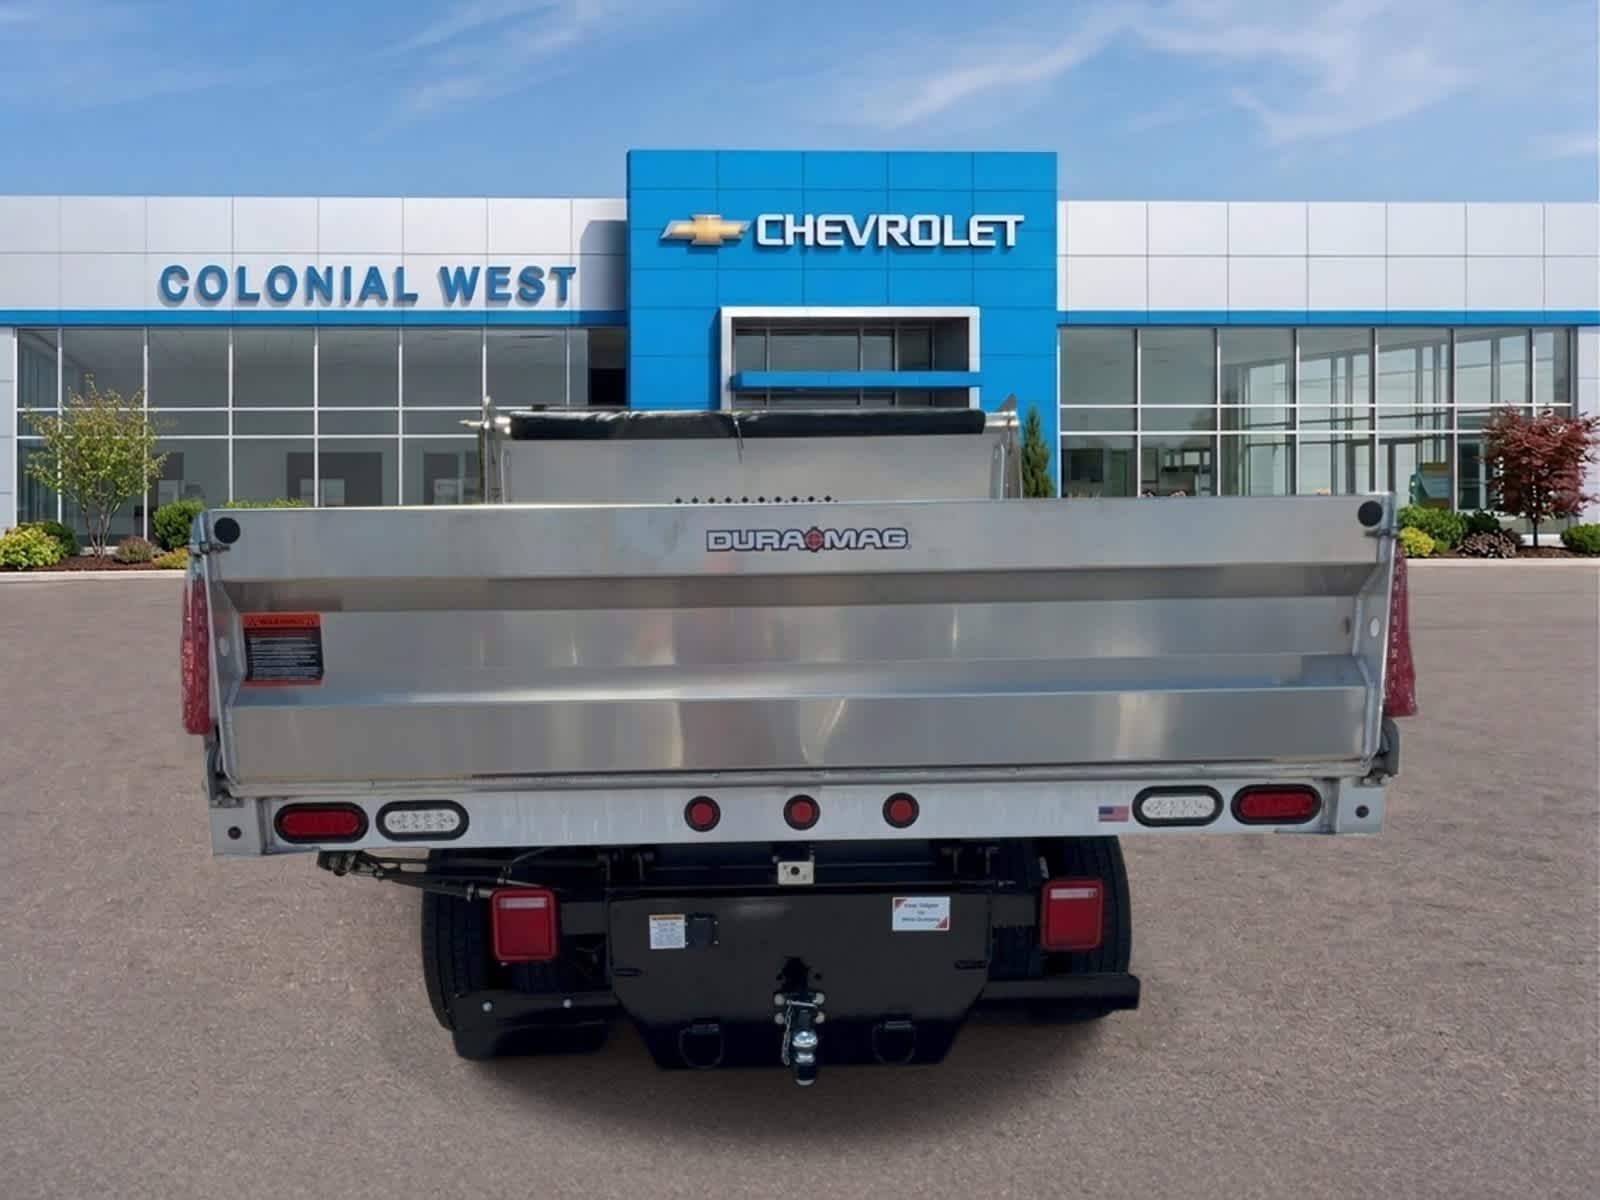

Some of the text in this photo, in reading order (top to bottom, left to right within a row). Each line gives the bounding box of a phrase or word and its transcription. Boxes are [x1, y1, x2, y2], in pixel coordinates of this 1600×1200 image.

[757, 213, 1025, 248] CHEVROLET
[159, 264, 577, 304] COLONIAL WEST
